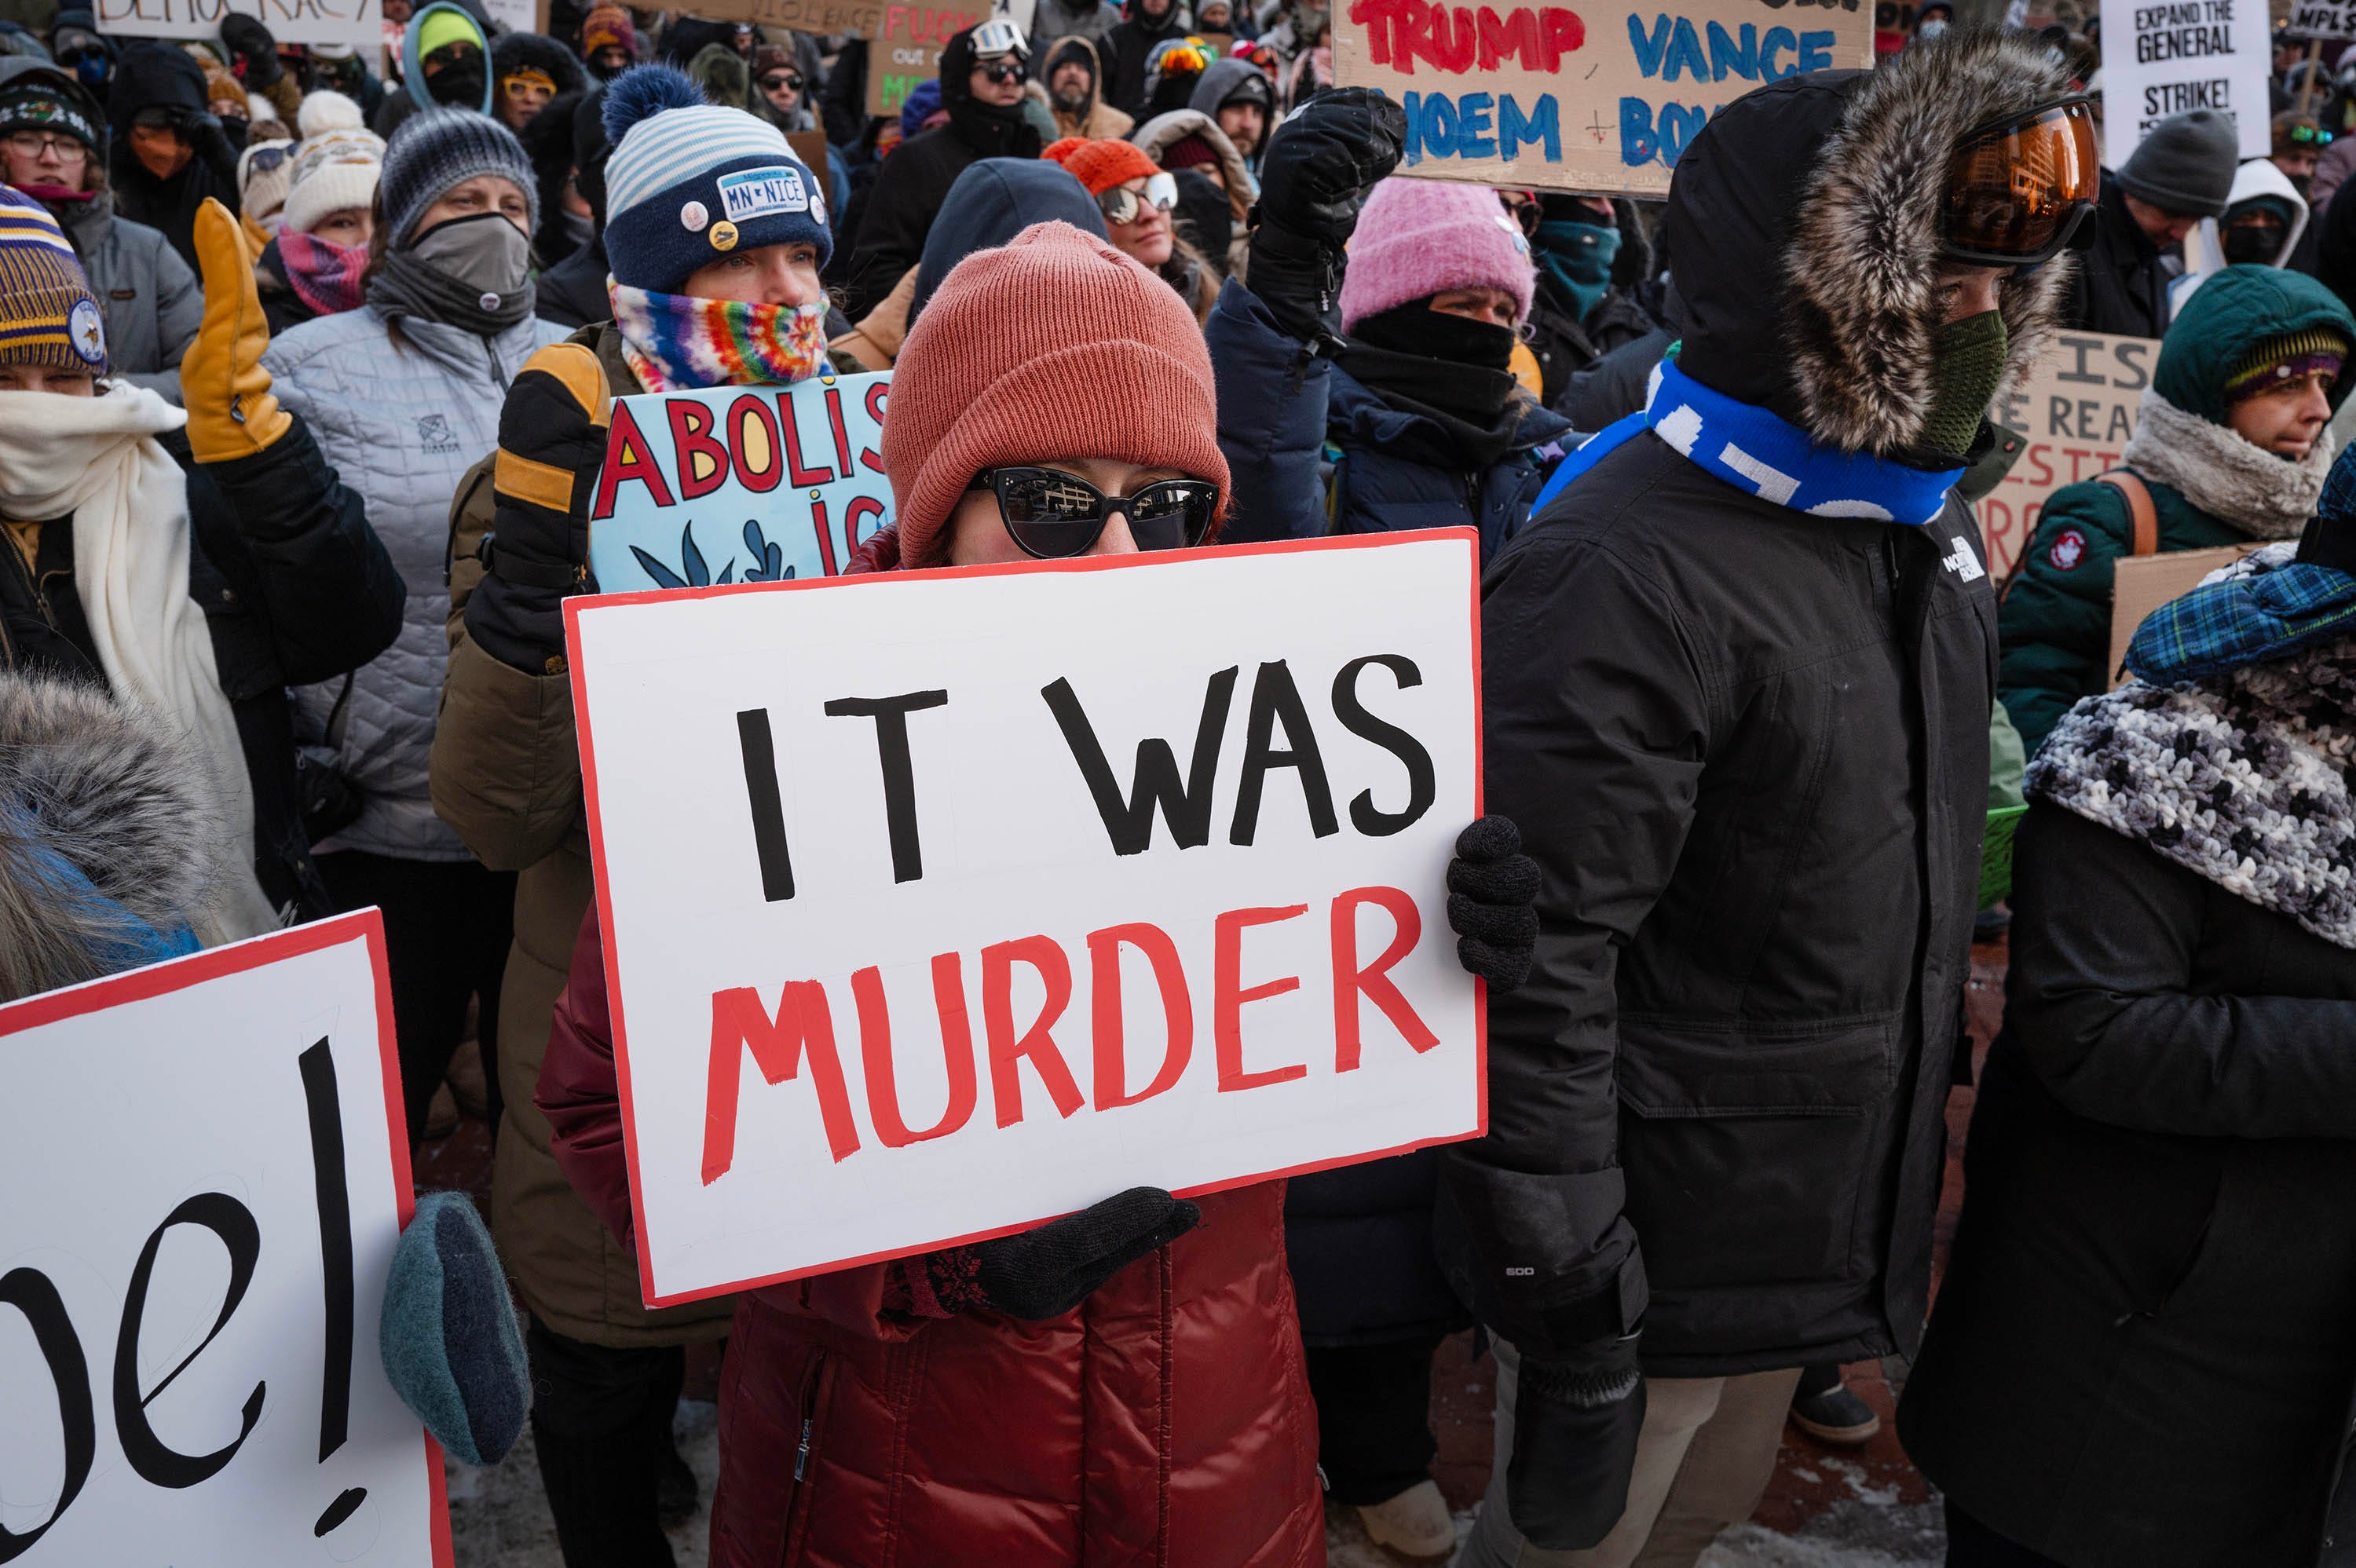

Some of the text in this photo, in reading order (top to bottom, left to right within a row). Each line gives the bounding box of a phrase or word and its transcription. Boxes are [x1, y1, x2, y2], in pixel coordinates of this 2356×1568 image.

[884, 4, 978, 43] FUCK
[2134, 0, 2234, 31] EXPAND THE
[2297, 7, 2356, 33] MPLS
[1627, 13, 1836, 84] VANCE
[2137, 25, 2235, 63] GENERAL
[2145, 79, 2230, 115] STRIKE!
[726, 185, 753, 211] MN
[763, 180, 803, 203] NICE
[2057, 337, 2149, 390] IS
[2050, 396, 2141, 441] REA
[737, 653, 1436, 901] IT WAS
[701, 886, 1440, 1187] MURDER
